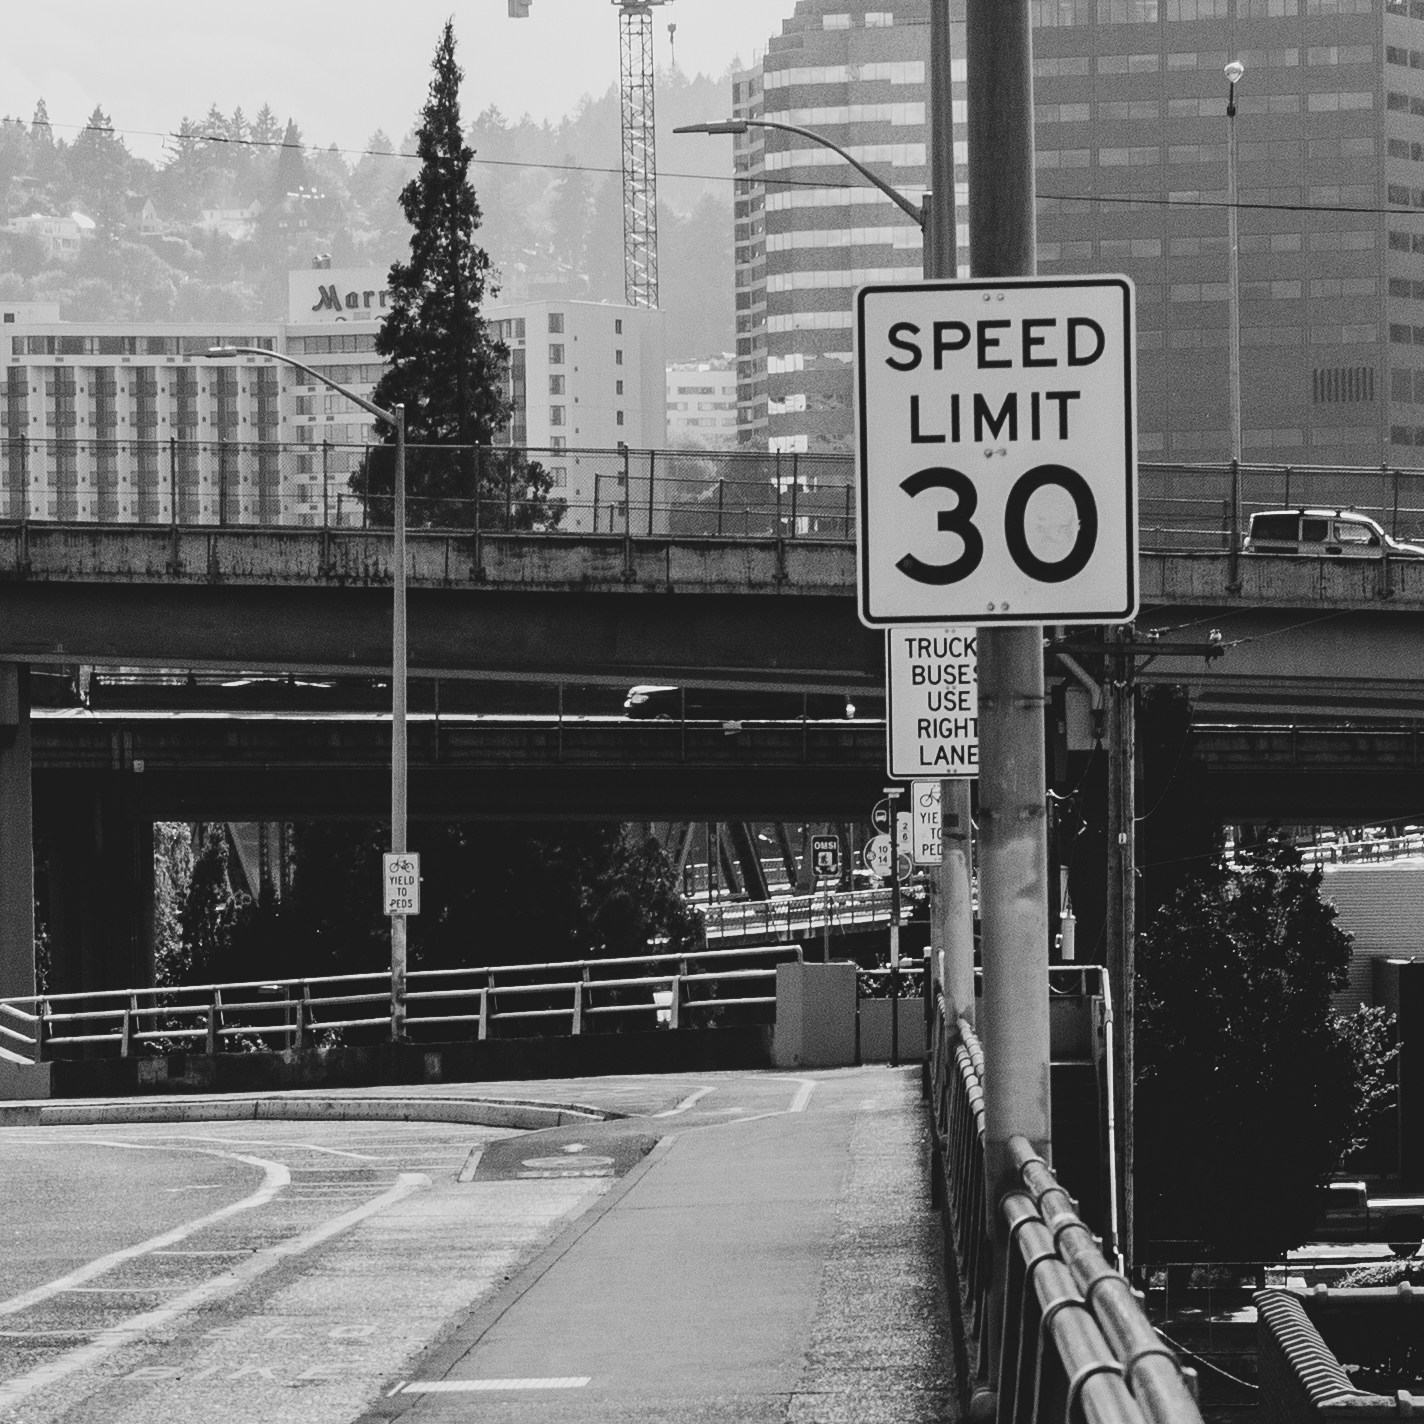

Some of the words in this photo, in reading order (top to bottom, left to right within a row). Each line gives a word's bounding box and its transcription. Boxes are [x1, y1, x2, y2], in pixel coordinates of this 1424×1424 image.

[312, 284, 393, 311] Marr
[885, 317, 1105, 372] SPEED
[910, 390, 1081, 444] LIMIT
[895, 464, 1098, 585] 30
[904, 637, 977, 658] TRUCK
[928, 691, 971, 711] USE
[918, 718, 978, 738] RIGHT
[920, 745, 979, 765] LANE
[920, 812, 939, 823] YIE
[814, 841, 837, 850] OMSI
[878, 845, 888, 853] 10
[922, 844, 942, 855] PED
[389, 875, 415, 885] YIELD
[397, 887, 407, 897] TO
[390, 899, 413, 908] PEDS
